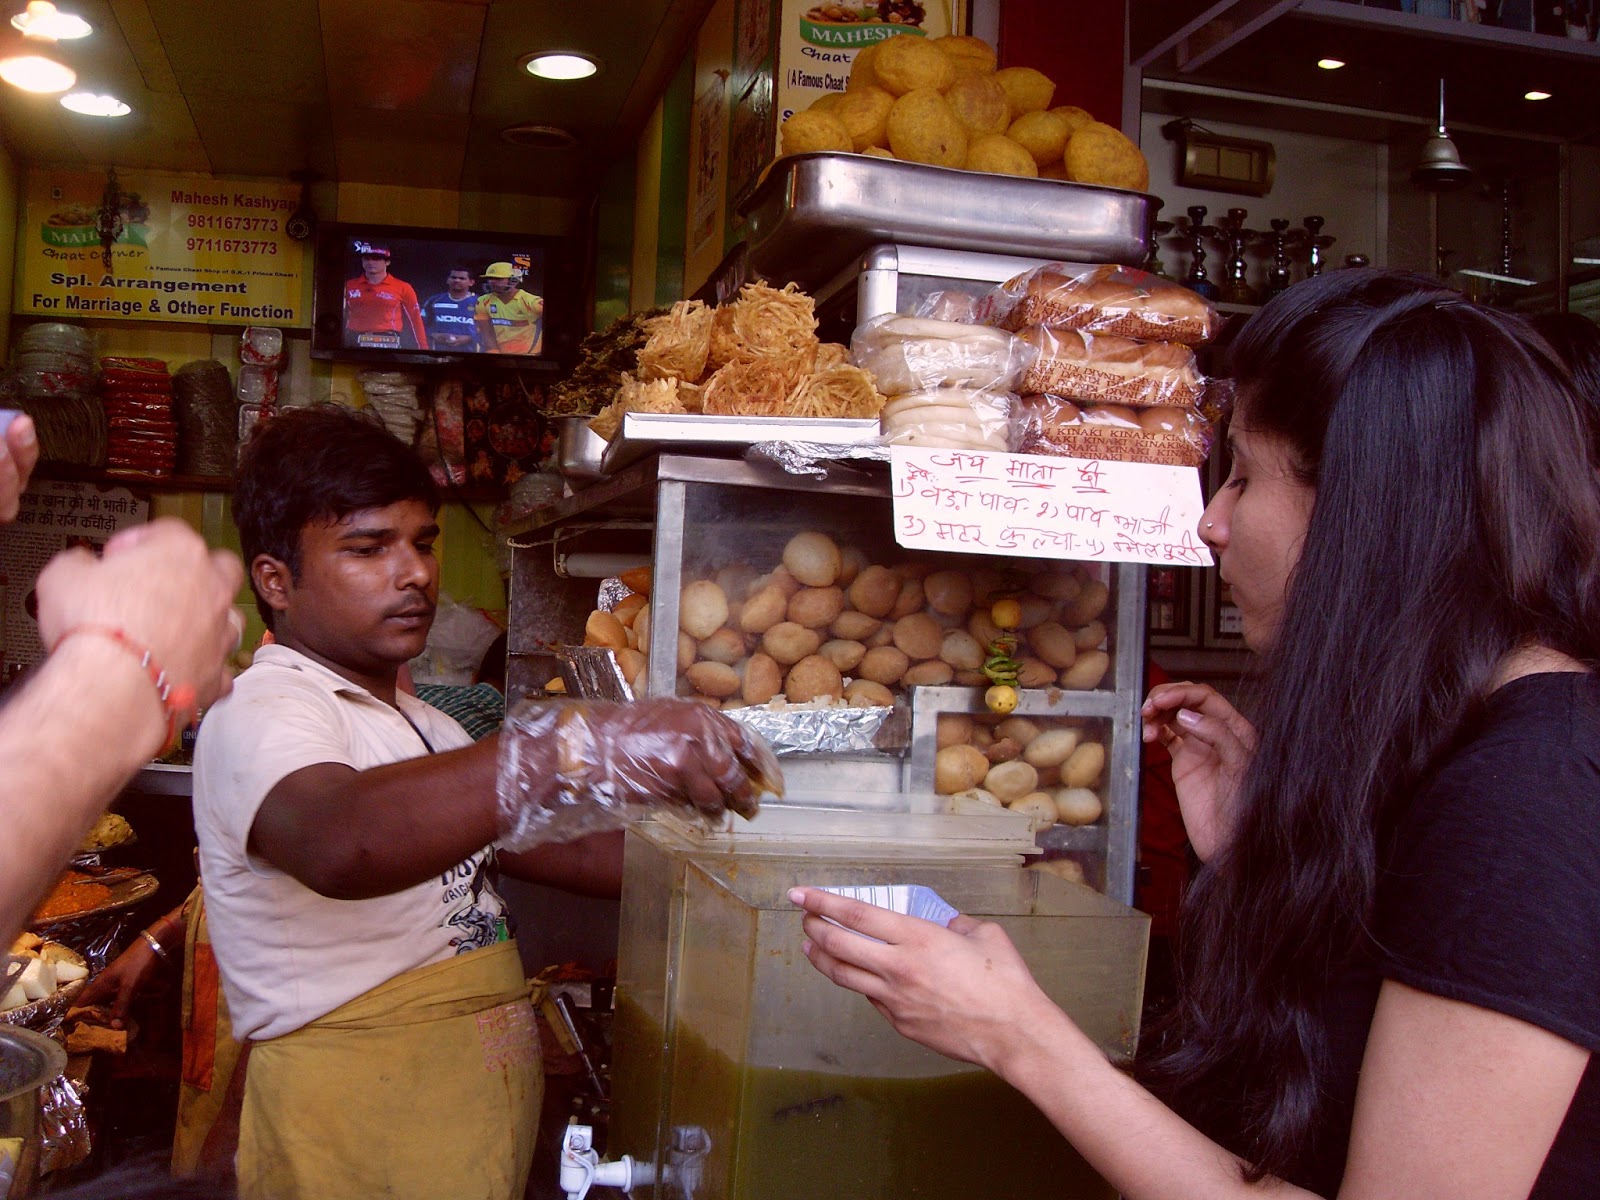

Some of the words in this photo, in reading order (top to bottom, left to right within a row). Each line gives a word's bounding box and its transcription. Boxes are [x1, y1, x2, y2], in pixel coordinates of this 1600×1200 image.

[801, 47, 851, 63] Chaat
[798, 70, 823, 89] Famous
[825, 73, 844, 91] Chaat
[171, 190, 228, 206] Mahesh
[188, 214, 279, 232] 9811673773
[42, 248, 85, 261] Chaat
[90, 250, 145, 261] Crner
[187, 238, 278, 255] 9711673773
[51, 273, 92, 288] Spl.
[100, 275, 247, 294] Arrangement
[32, 294, 59, 309] For
[65, 295, 142, 315] Marriage
[149, 299, 161, 313] &
[167, 300, 214, 316] Other
[220, 302, 294, 320] Function
[436, 315, 474, 326] NOKIA
[1057, 428, 1102, 437] KINAKI
[1110, 430, 1155, 440] KINAKI
[1084, 437, 1127, 446] KINAKI
[1135, 440, 1180, 450] KINAKI
[1106, 445, 1150, 456] KINAKI
[1080, 452, 1123, 461] KINAKI
[930, 453, 990, 474] जय
[1006, 458, 1067, 480] माता
[1077, 460, 1107, 488] दी
[87, 495, 101, 511] भी
[103, 498, 127, 513] भाती
[1065, 502, 1110, 528] पाव
